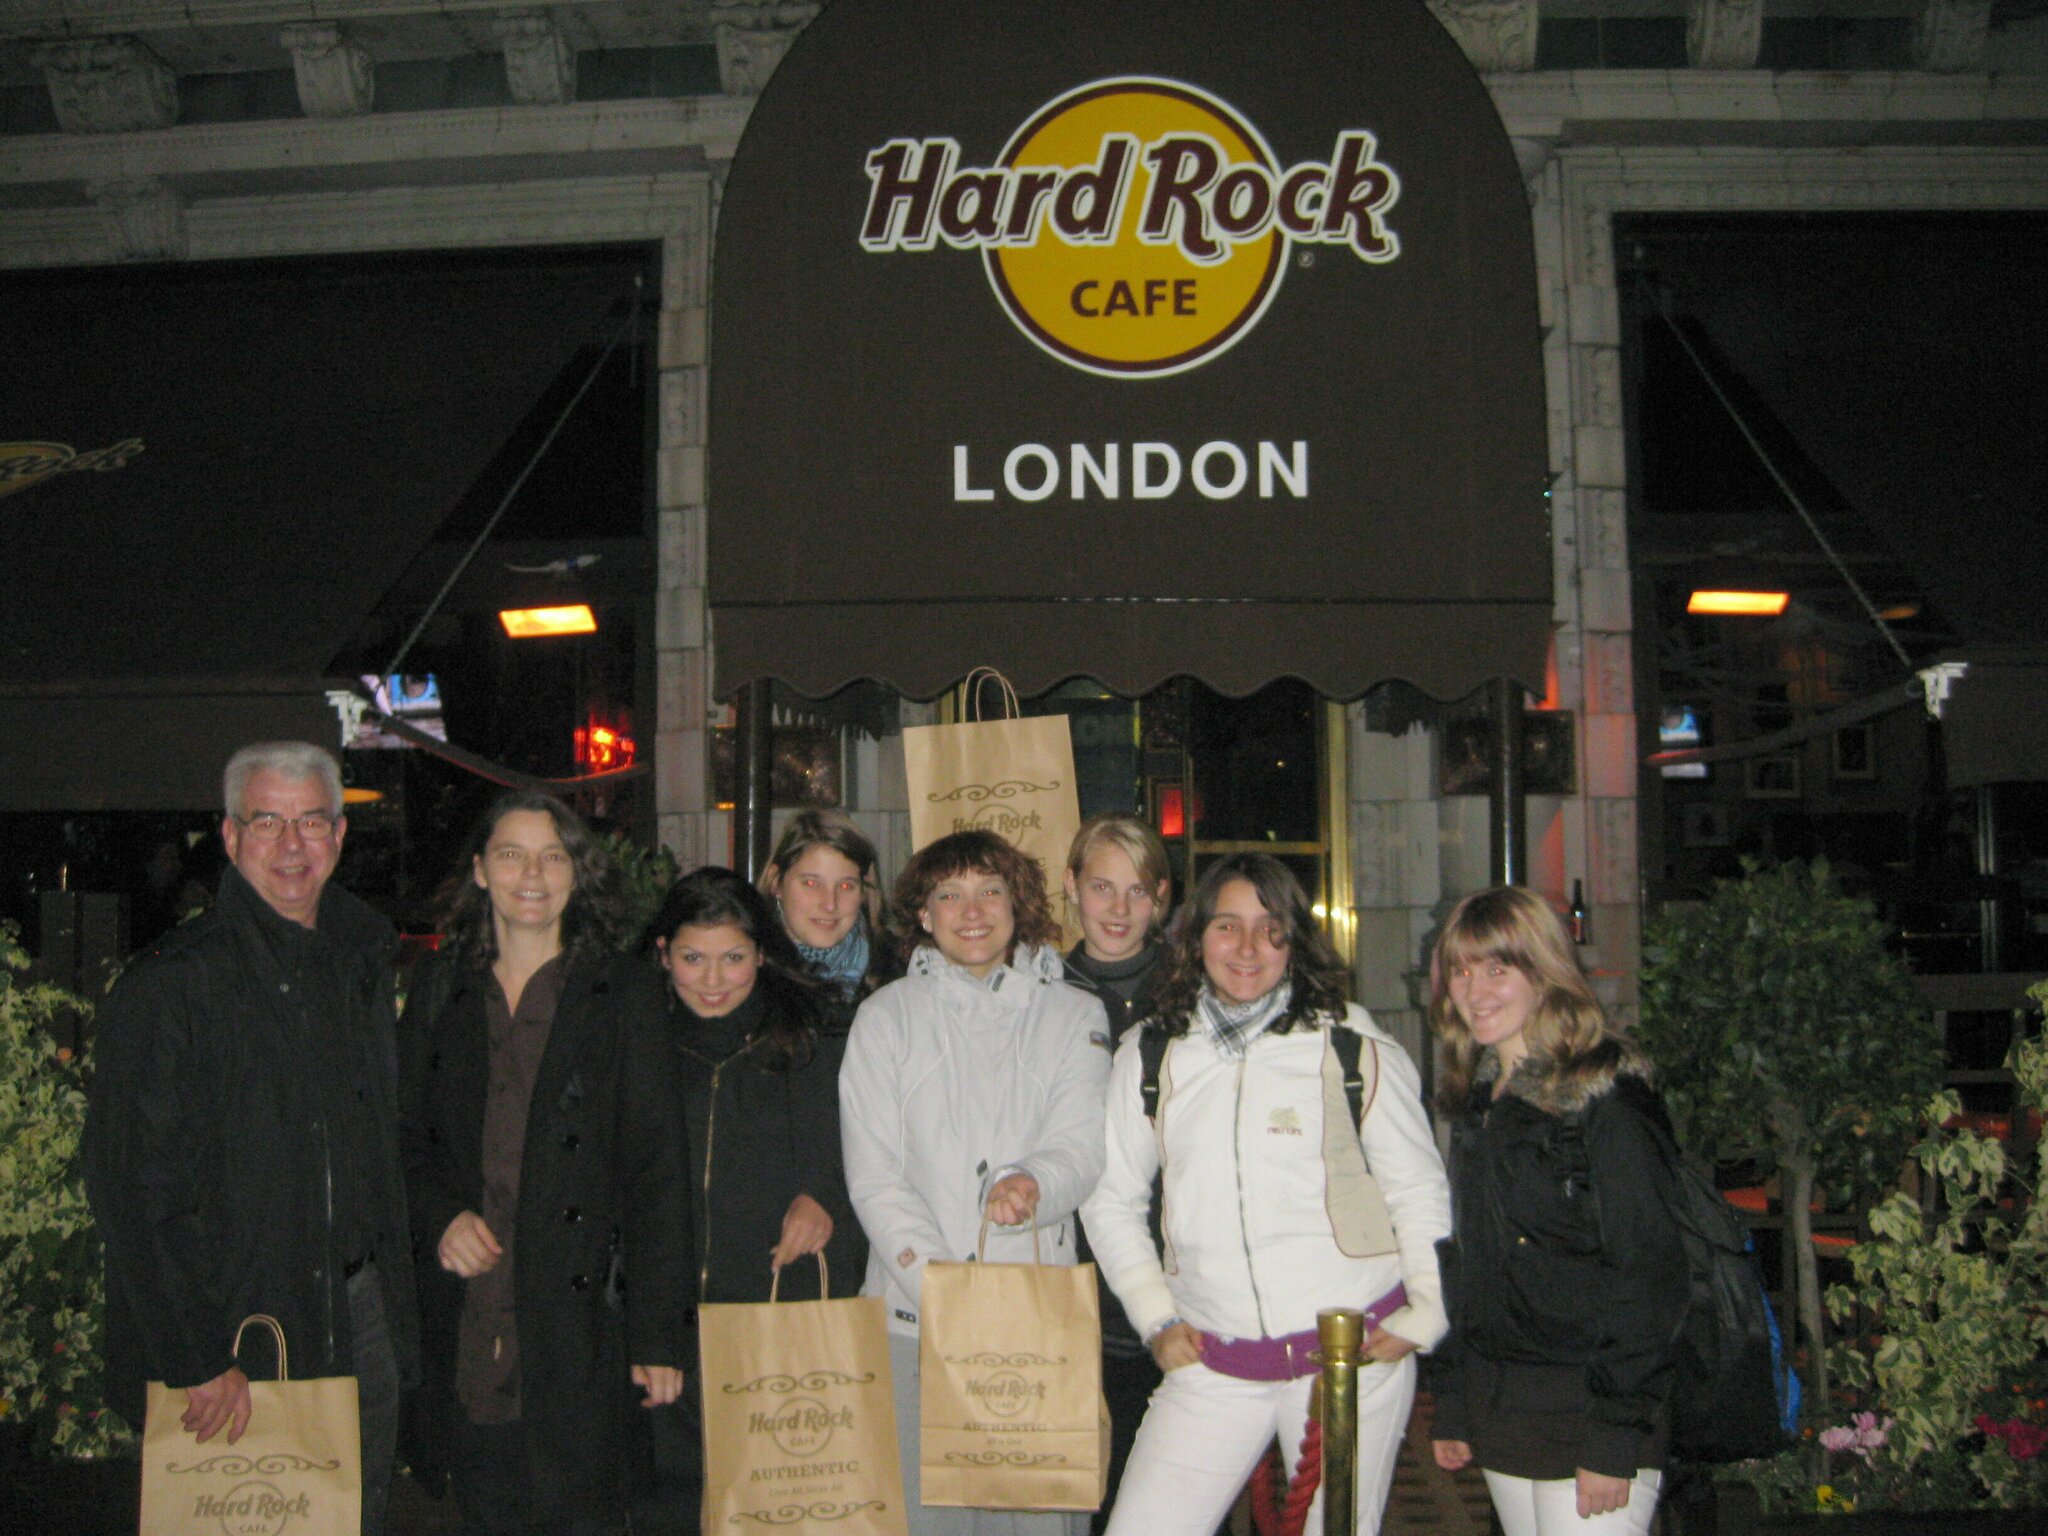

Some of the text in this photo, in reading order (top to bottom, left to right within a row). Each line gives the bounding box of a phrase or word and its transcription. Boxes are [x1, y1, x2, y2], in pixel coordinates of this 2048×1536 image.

[860, 131, 1400, 266] Hard Rock
[1069, 278, 1199, 319] CAFE
[952, 440, 1309, 502] LONDON
[998, 808, 1042, 833] Rock
[964, 1379, 1007, 1398] Hard
[748, 1405, 854, 1434] Hard Rock
[751, 1461, 859, 1482] AUTHENTIC
[194, 1491, 310, 1519] Hard Rock
